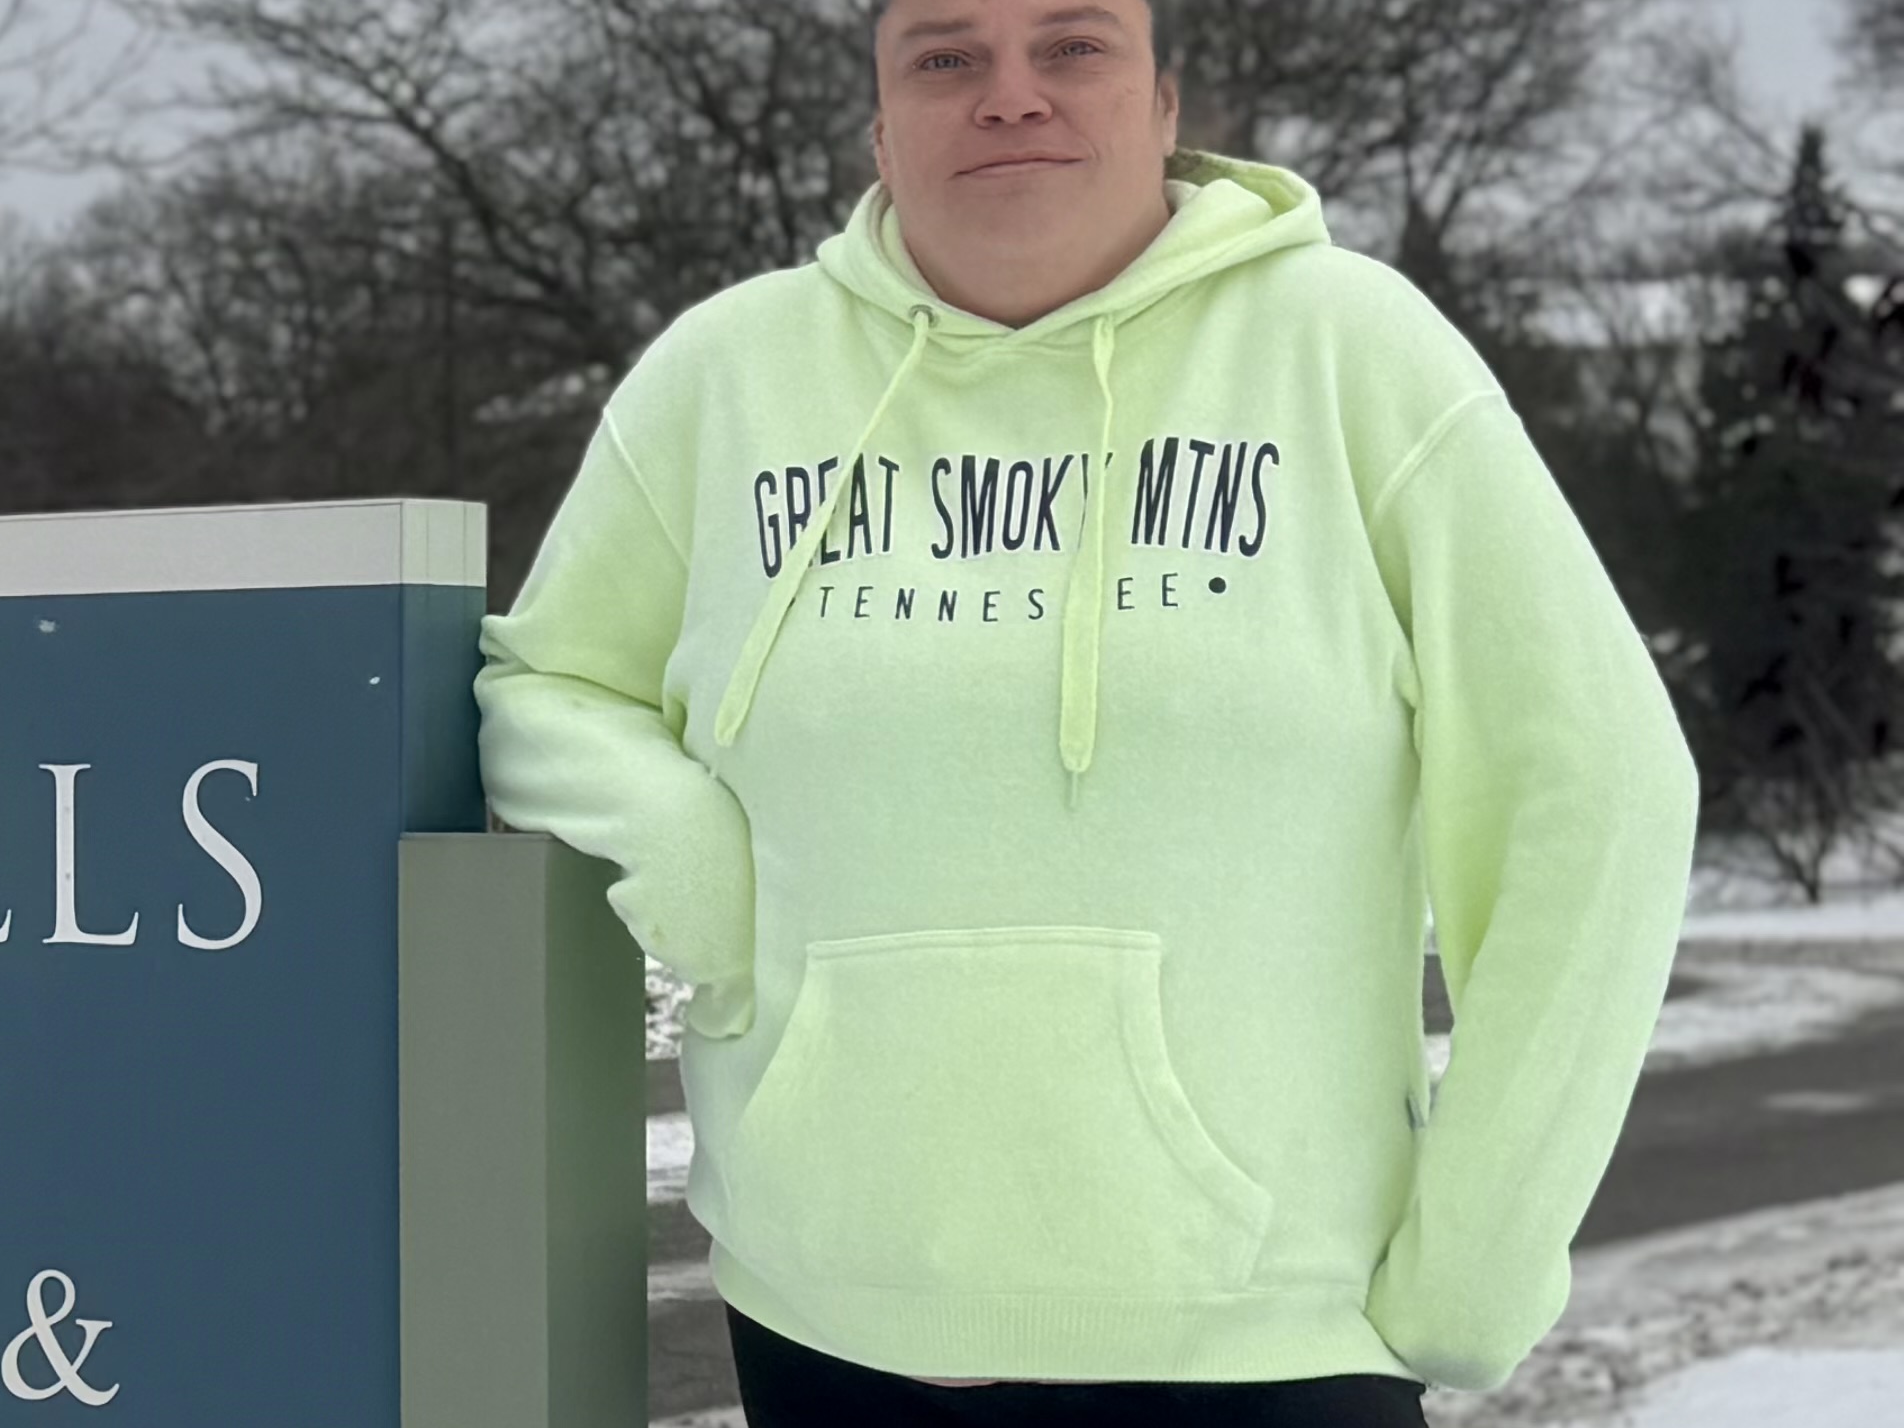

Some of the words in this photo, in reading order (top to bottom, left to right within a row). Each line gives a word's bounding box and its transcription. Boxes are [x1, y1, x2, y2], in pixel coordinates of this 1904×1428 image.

[754, 453, 900, 579] GREAT
[1131, 436, 1280, 558] MTNS
[819, 572, 1179, 623] TENNESEE
[0, 1269, 120, 1407] &
